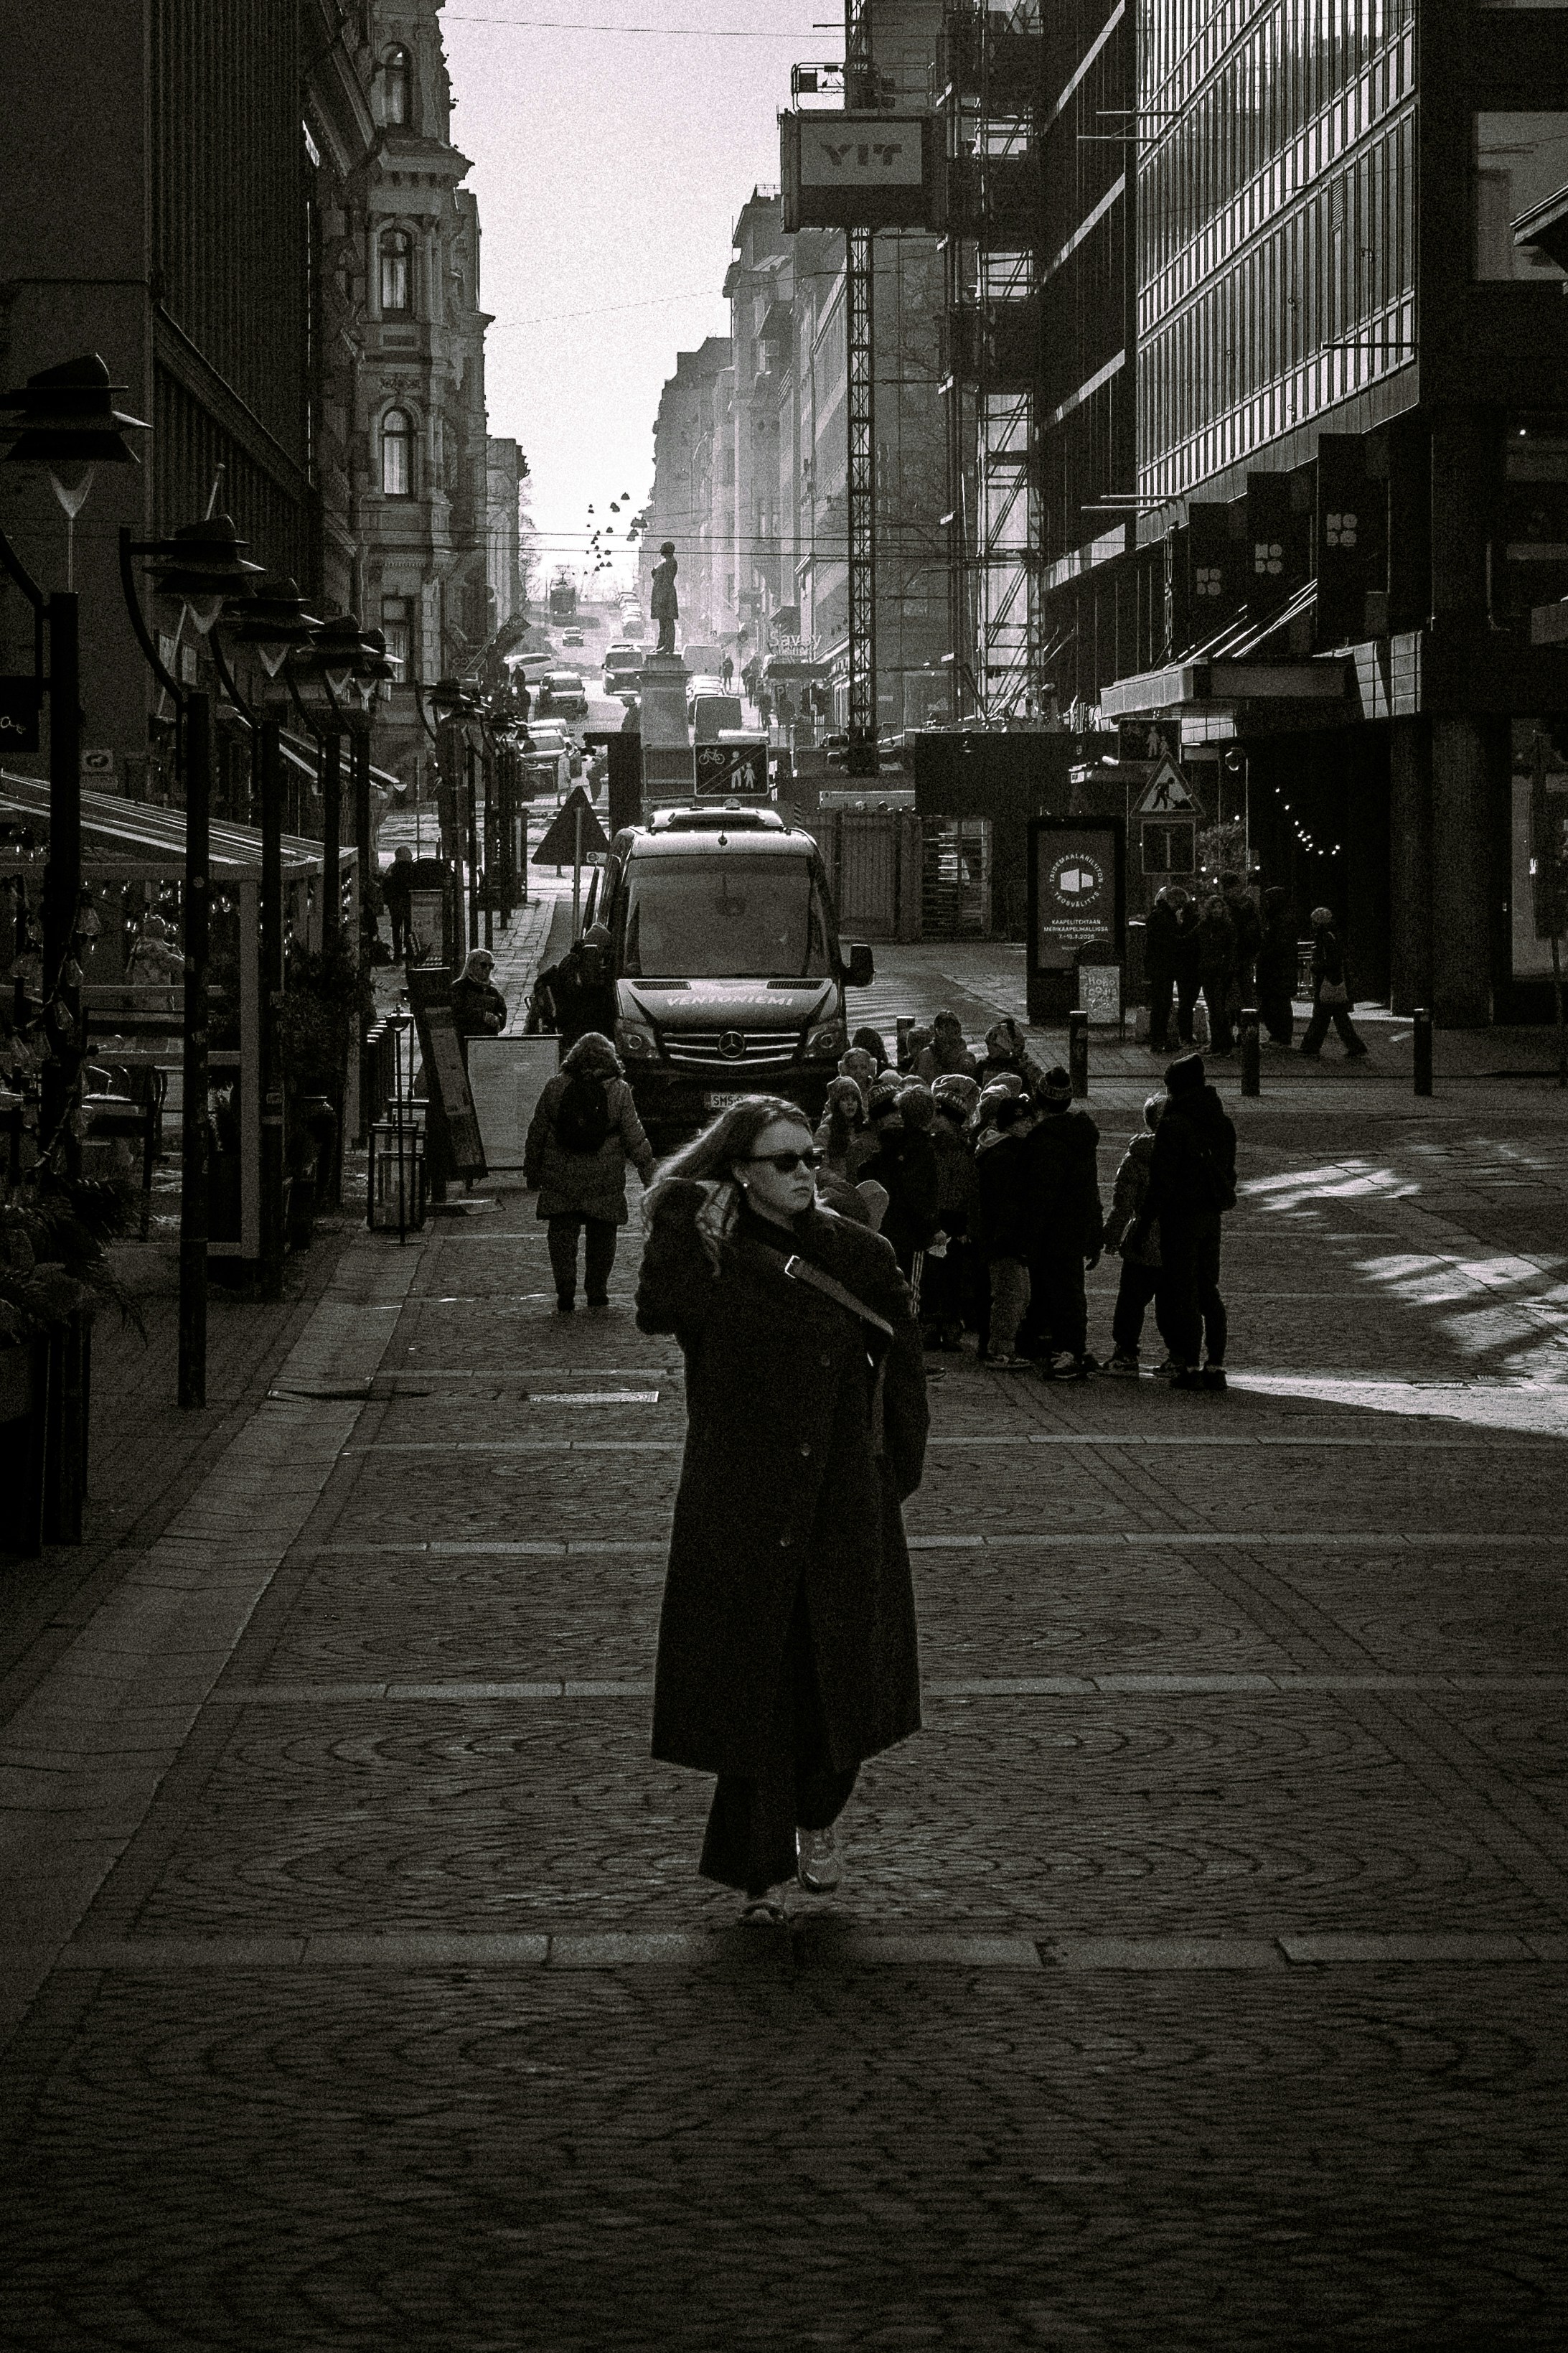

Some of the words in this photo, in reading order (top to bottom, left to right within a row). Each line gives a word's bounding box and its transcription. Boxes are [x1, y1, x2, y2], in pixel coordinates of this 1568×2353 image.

[820, 143, 903, 167] YIT
[769, 629, 822, 650] Savoy
[1049, 853, 1104, 883] TAIDEMAALARILIITON
[666, 995, 794, 1006] VENTONIEMI
